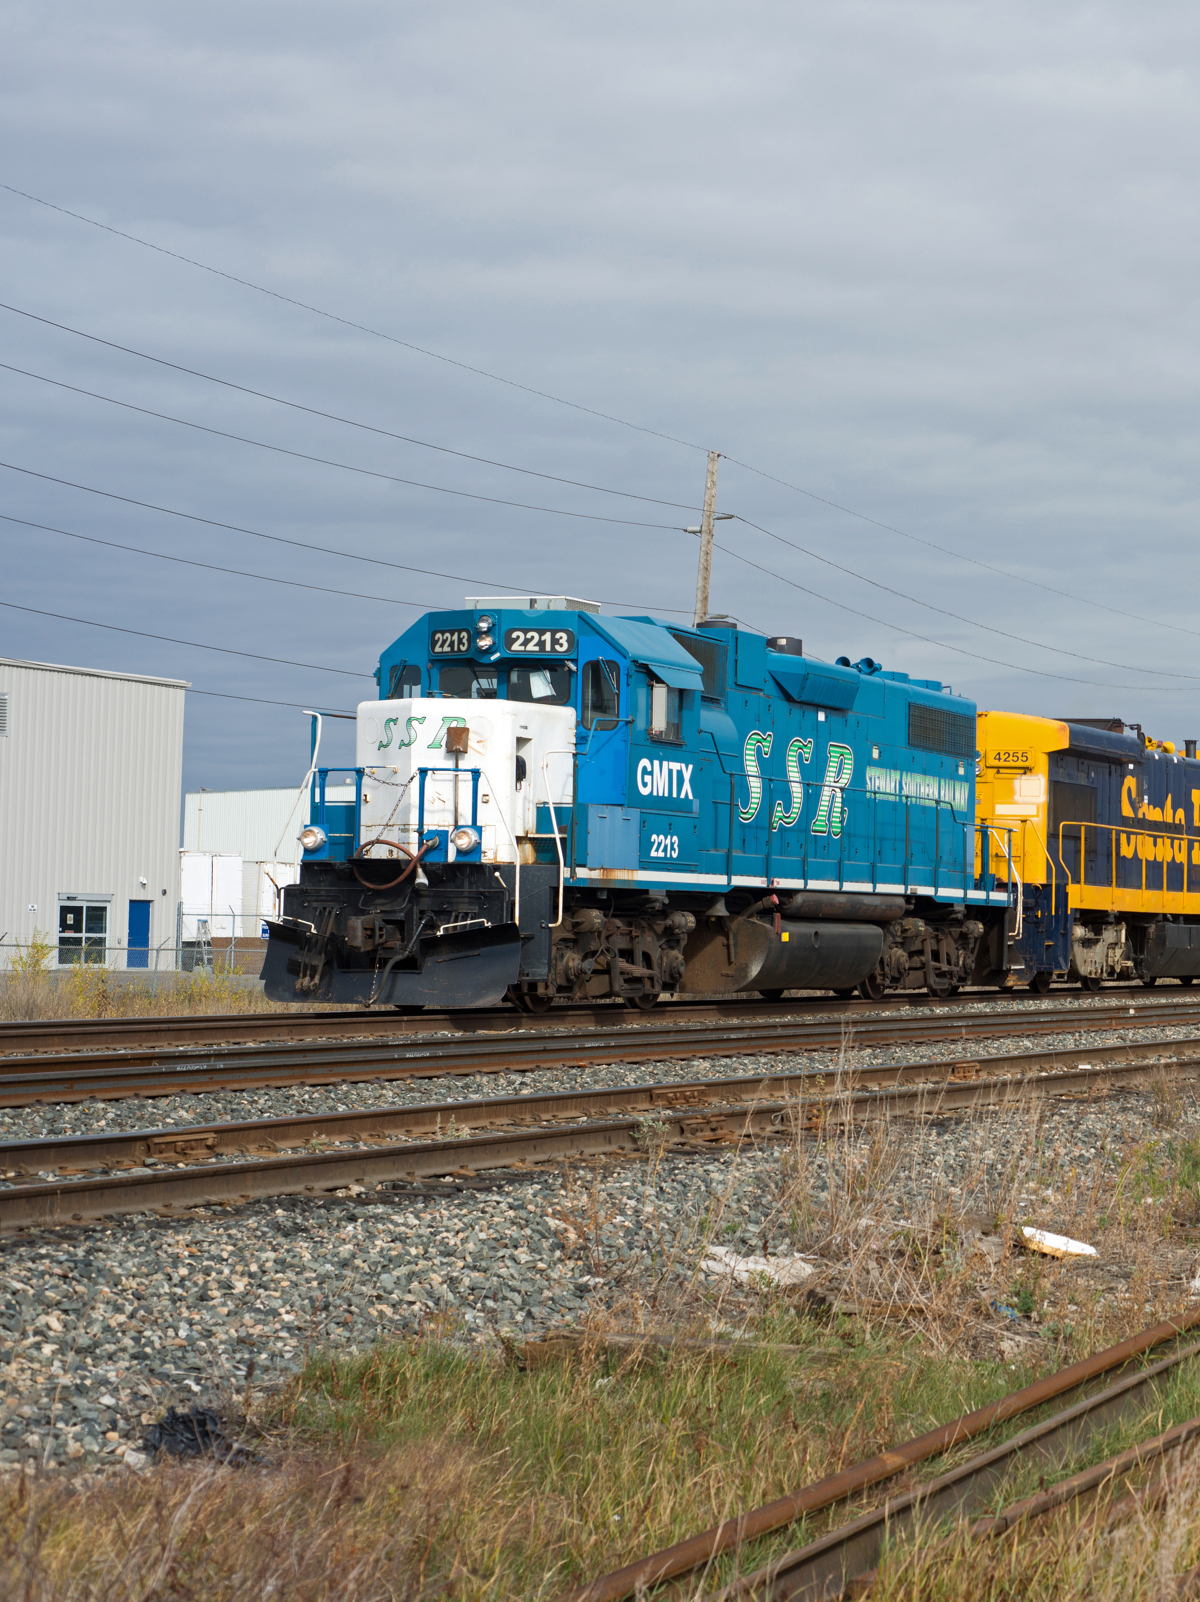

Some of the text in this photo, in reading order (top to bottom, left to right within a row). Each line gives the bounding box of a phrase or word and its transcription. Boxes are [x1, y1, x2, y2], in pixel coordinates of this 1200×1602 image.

[434, 630, 469, 653] 2213
[510, 630, 569, 653] 2213
[993, 751, 1029, 763] 4255
[636, 757, 694, 800] GMTX
[650, 833, 679, 859] 2213
